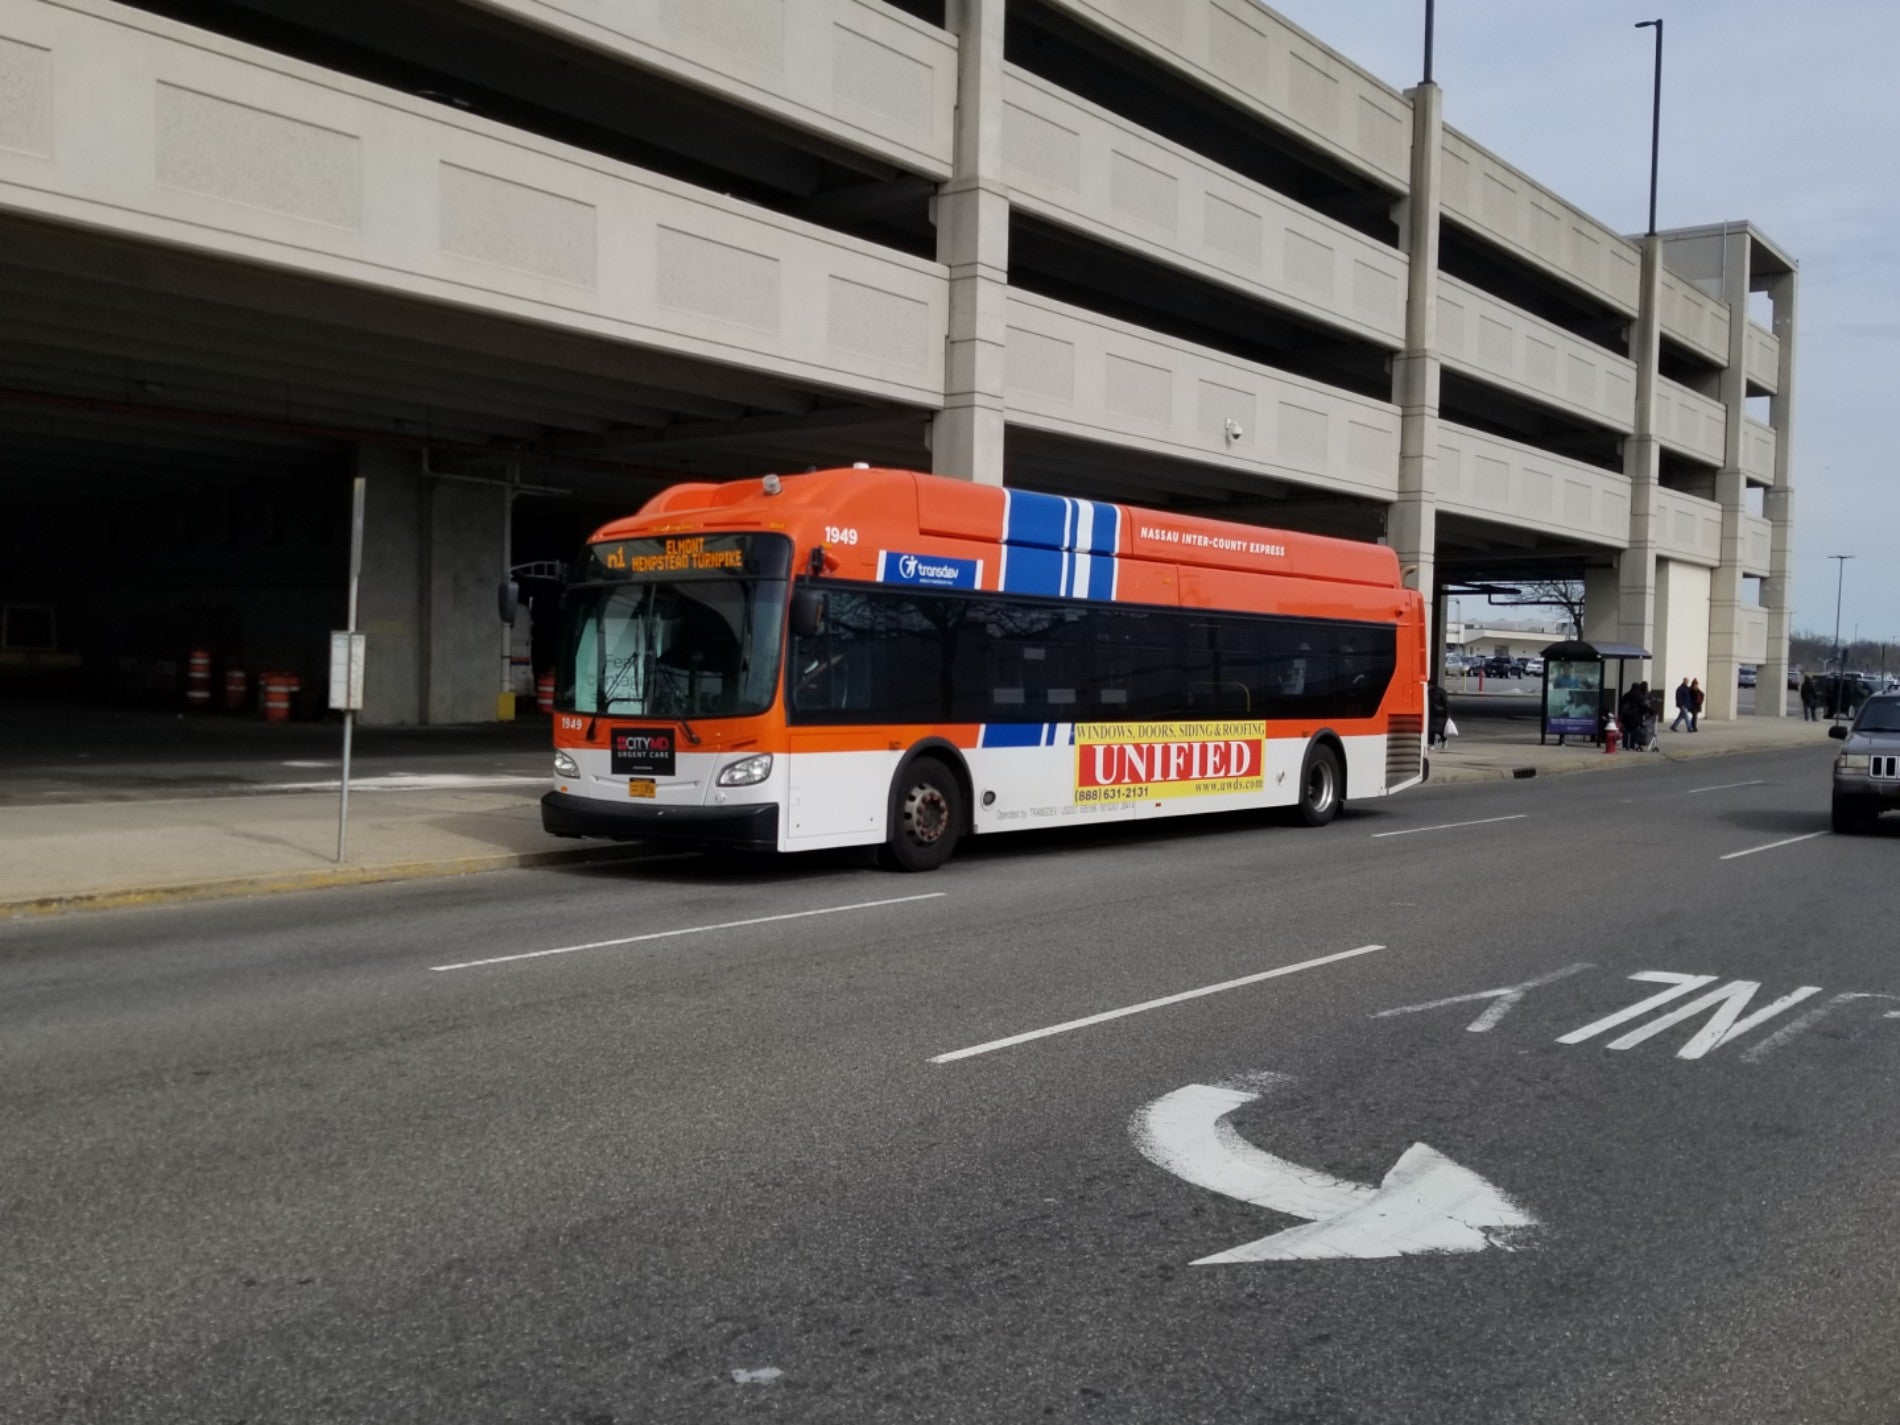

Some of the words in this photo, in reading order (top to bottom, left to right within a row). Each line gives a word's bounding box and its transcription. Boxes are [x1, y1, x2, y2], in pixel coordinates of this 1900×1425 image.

[825, 526, 858, 545] 1949
[1140, 527, 1179, 543] NASSAU
[1181, 533, 1247, 552] INTER-COUNTY
[1249, 542, 1285, 557] EXPRESS
[665, 538, 705, 555] ELMONT
[607, 546, 626, 569] n1
[631, 553, 690, 572] HEMPSTEAD
[692, 550, 743, 569] TURNPIKE
[917, 564, 959, 579] transdev
[562, 717, 582, 730] 1949
[1077, 724, 1136, 740] WINDOWS,
[1138, 724, 1177, 739] DOORS,
[1179, 723, 1213, 737] SIDING
[1222, 722, 1265, 736] ROOFING
[625, 737, 669, 750] CITYMD
[617, 751, 646, 759] URGENT
[649, 751, 669, 759] CARE
[1092, 740, 1251, 785] UNIFIED
[1195, 777, 1264, 792] www.uwds.com
[1074, 788, 1101, 803] (888)
[1103, 786, 1149, 799] 631-2131
